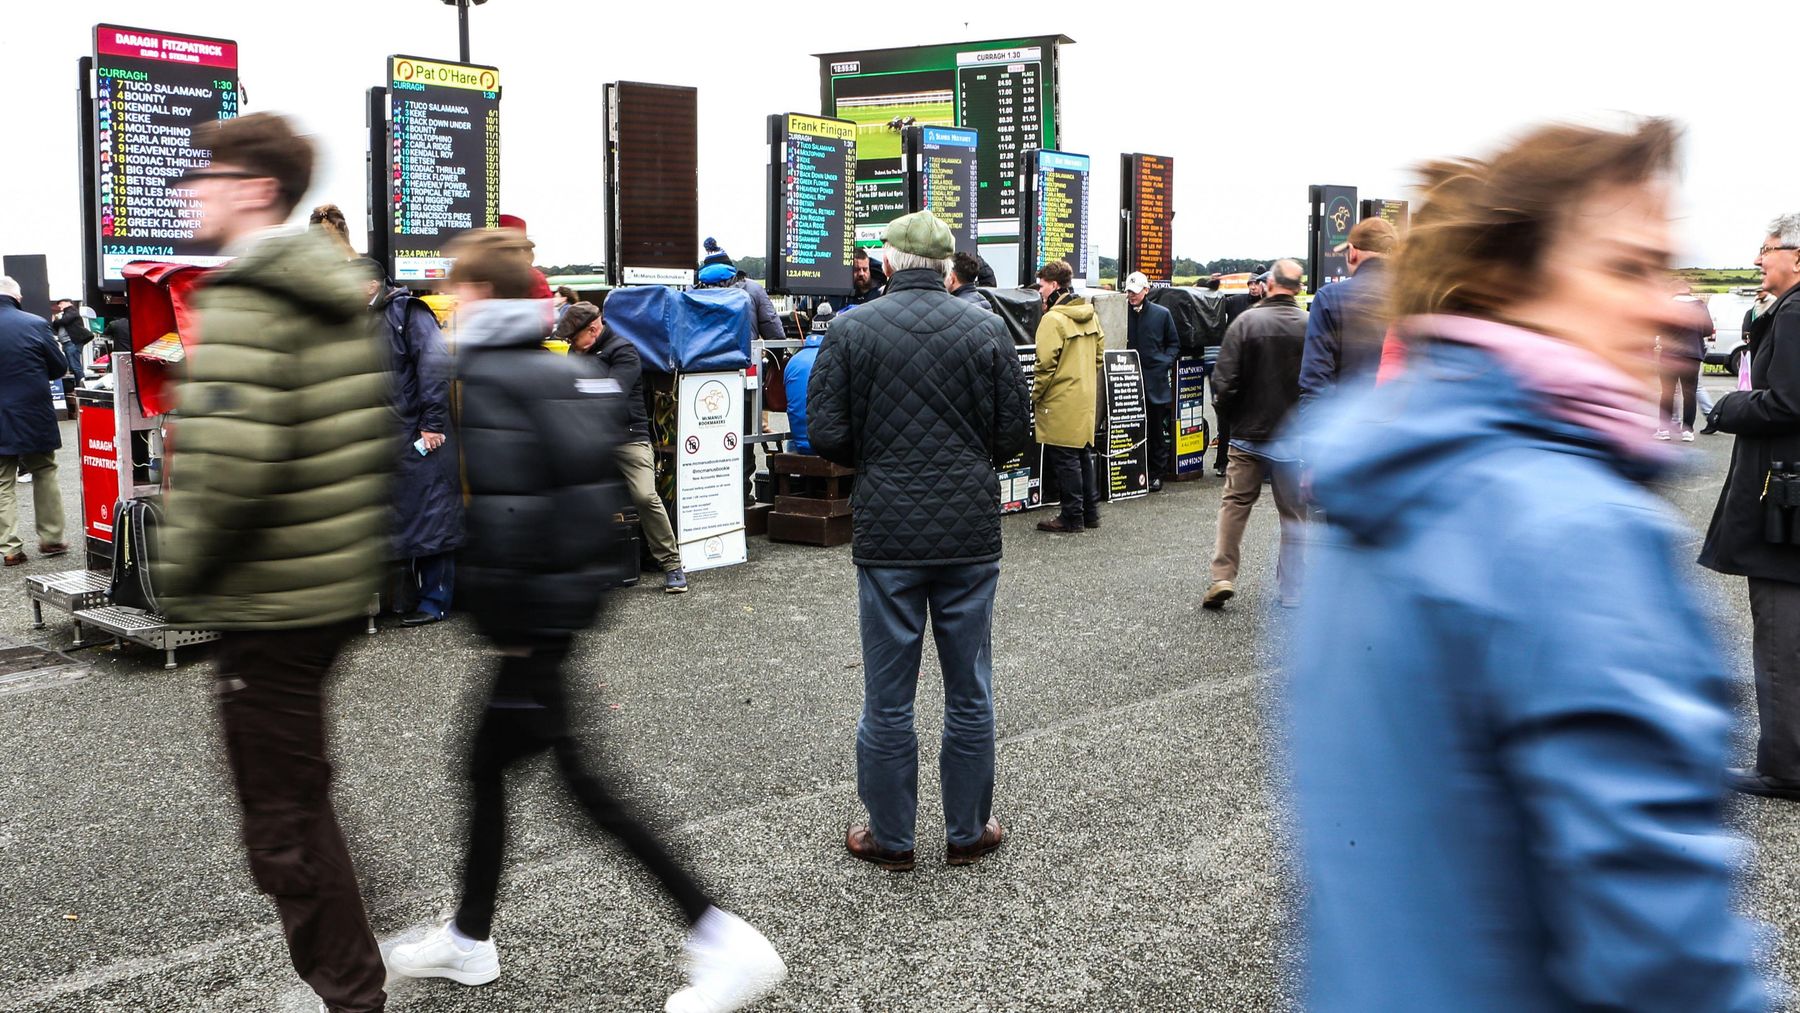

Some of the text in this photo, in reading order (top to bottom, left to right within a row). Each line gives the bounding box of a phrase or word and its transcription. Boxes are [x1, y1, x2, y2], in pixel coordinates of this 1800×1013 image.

[116, 34, 222, 56] DARAGH FITZPATRICK
[99, 68, 232, 90] CURRAGH 1:30
[416, 66, 477, 84] Pat O'Hare
[124, 81, 152, 92] TUCO
[222, 92, 236, 100] 6/1
[394, 81, 425, 91] CURRAGH
[125, 92, 165, 104] BOUNTY
[223, 101, 236, 110] 9/1
[112, 101, 124, 110] 10
[125, 102, 170, 115] KENDALL
[172, 106, 192, 116] ROY
[410, 102, 427, 110] TUCO
[429, 104, 469, 114] SALAMANCA
[117, 112, 151, 123] 3 KEKE
[113, 122, 190, 136] 14 MOLTOPHINO
[410, 126, 436, 134] BOUNTY
[429, 119, 448, 127] DOWN
[450, 121, 471, 130] UNDER
[792, 119, 852, 139] Frank Finigan
[118, 133, 190, 146] 2 CARLA RIDGE
[410, 134, 452, 143] MOLTOPHINO
[118, 144, 212, 158] 9 HEAVENLY POWER
[410, 150, 439, 158] KENDALL
[113, 154, 210, 168] 18 KODIAC THRILLER
[119, 165, 184, 177] 1 BIG GOSSEY
[436, 166, 465, 175] THRILLER
[114, 175, 165, 186] 13 BETSEN
[433, 174, 458, 182] FLOWER
[410, 181, 443, 189] HEAVENLY
[114, 186, 200, 197] 16 SIR LES PATTE
[410, 188, 442, 196] TROPICAL
[443, 190, 470, 198] RETREAT
[127, 197, 154, 206] BACK
[157, 198, 186, 208] DOWN
[114, 207, 126, 215] 19
[127, 208, 176, 218] TROPICAL
[114, 218, 200, 228] 22 GREEK FLOWER
[114, 228, 193, 238] 24 JON RIGGENS
[89, 439, 112, 451] DARAGH
